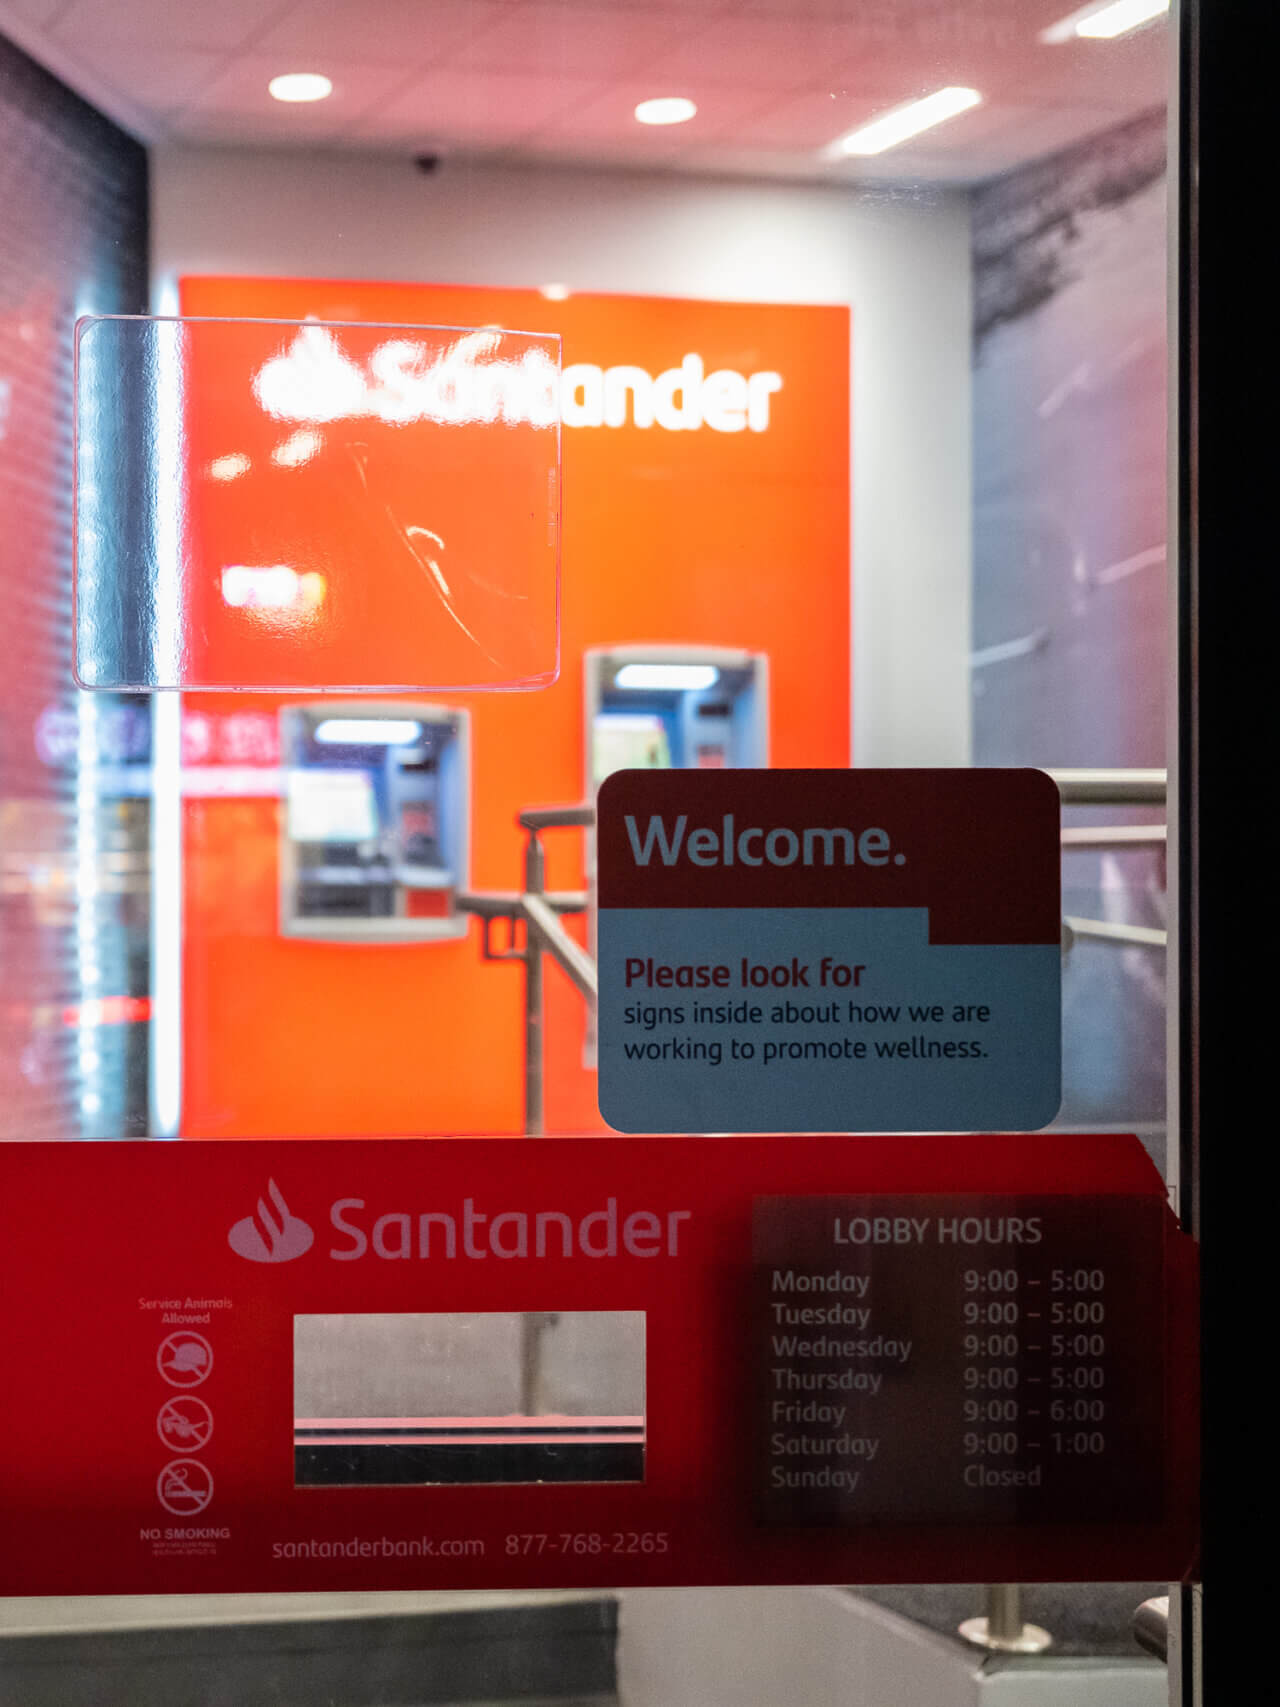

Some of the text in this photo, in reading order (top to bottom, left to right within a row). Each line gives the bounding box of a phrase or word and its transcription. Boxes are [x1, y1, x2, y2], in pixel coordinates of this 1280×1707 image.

[370, 341, 782, 431] Santander
[624, 814, 905, 866] Welcome.
[626, 958, 865, 988] Please look for
[625, 1001, 990, 1030] signs inside about how we are
[624, 1036, 988, 1066] working to promote wellness.
[330, 1198, 690, 1260] Santander
[835, 1218, 1041, 1244] LOBBY HOURS
[773, 1271, 870, 1298] Monday
[964, 1270, 1017, 1291] 9:00
[1052, 1270, 1104, 1291] 5:00
[139, 1297, 232, 1309] Service Animals
[772, 1303, 871, 1330] Tuesday
[964, 1302, 1017, 1324] 9:00
[1052, 1302, 1104, 1323] 5:00
[162, 1312, 210, 1323] Allowed
[773, 1336, 912, 1362] Wednesday
[964, 1335, 1017, 1356] 9:00
[1052, 1334, 1104, 1356] 5:00
[772, 1368, 881, 1395] Thursday
[964, 1367, 1017, 1389] 9:00
[1052, 1367, 1104, 1388] 5:00
[773, 1401, 847, 1428] Friday
[964, 1400, 1016, 1421] 9:00
[1051, 1400, 1104, 1421] 6:00
[772, 1432, 880, 1461] Saturday
[963, 1432, 1016, 1455] 9:00
[1053, 1432, 1104, 1453] 1:00
[772, 1464, 1040, 1493] Sunday Closed
[140, 1528, 230, 1539] NO SMOKING
[273, 1532, 667, 1558] santanderbank.com 877-768-2265
